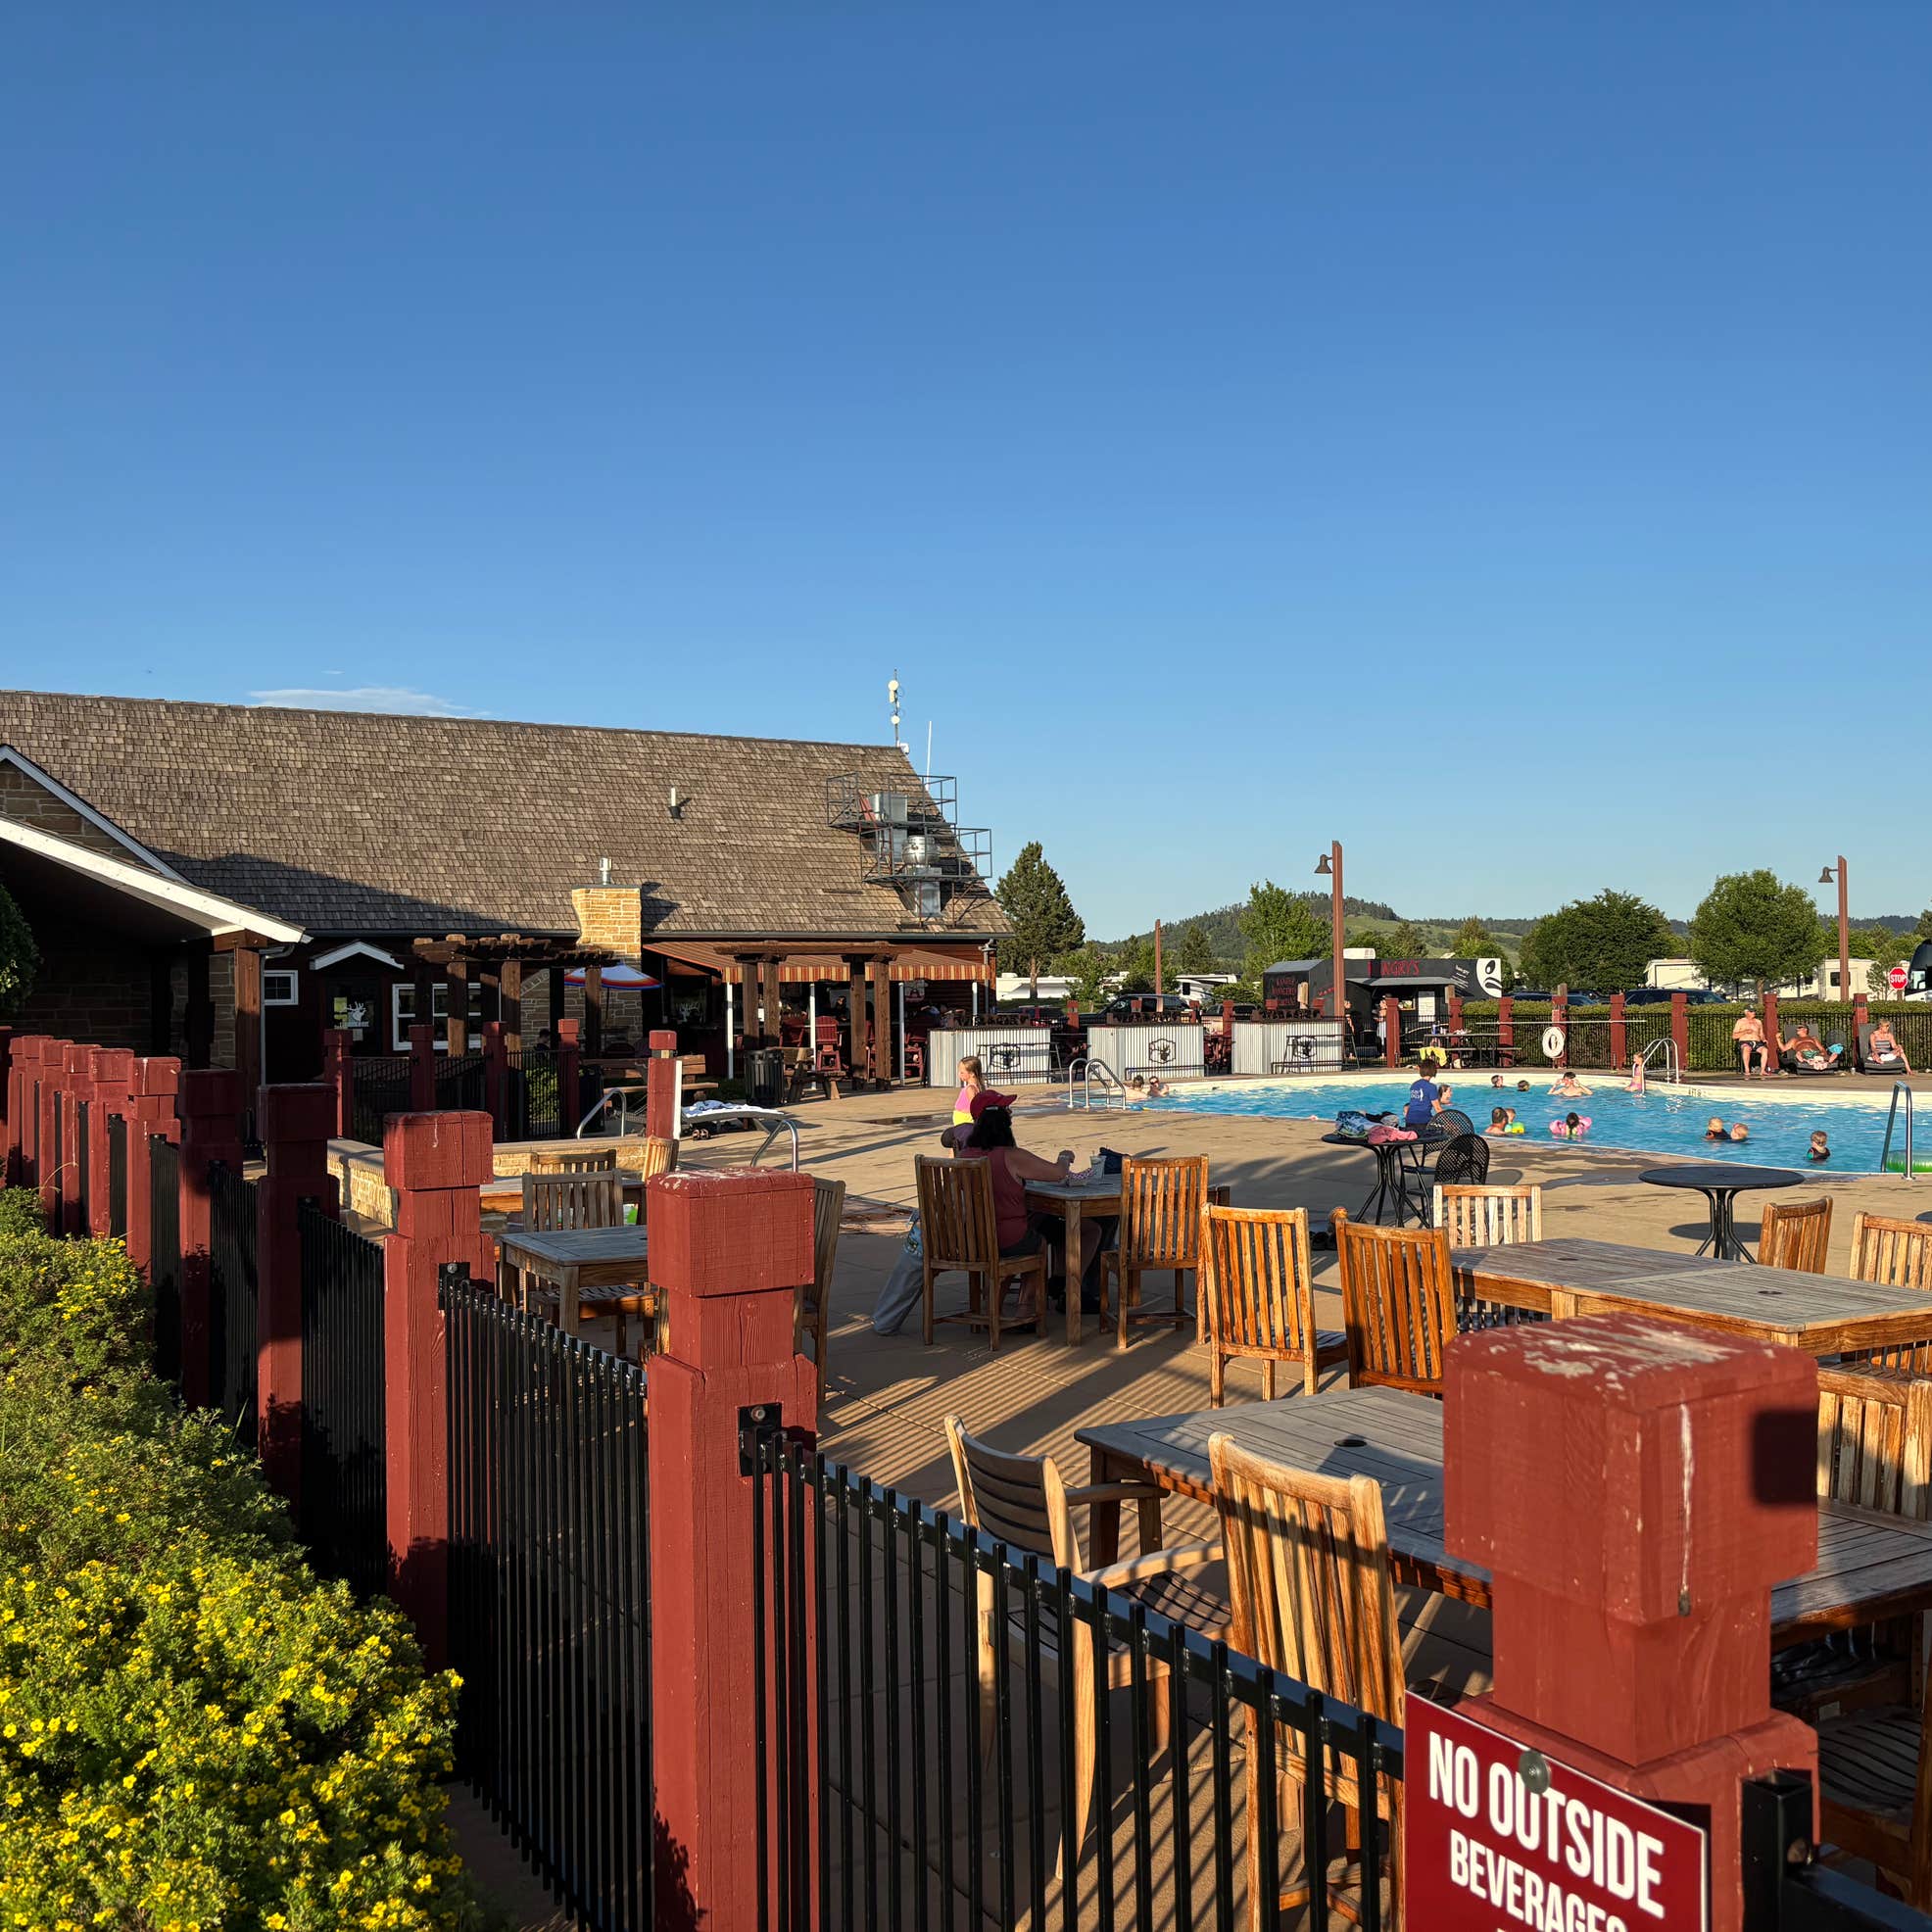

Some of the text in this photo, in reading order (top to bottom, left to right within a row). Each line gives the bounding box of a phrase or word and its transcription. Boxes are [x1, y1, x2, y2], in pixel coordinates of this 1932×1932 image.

[1890, 974, 1907, 983] STOP
[1428, 1730, 1666, 1920] NO OUTSIDE
